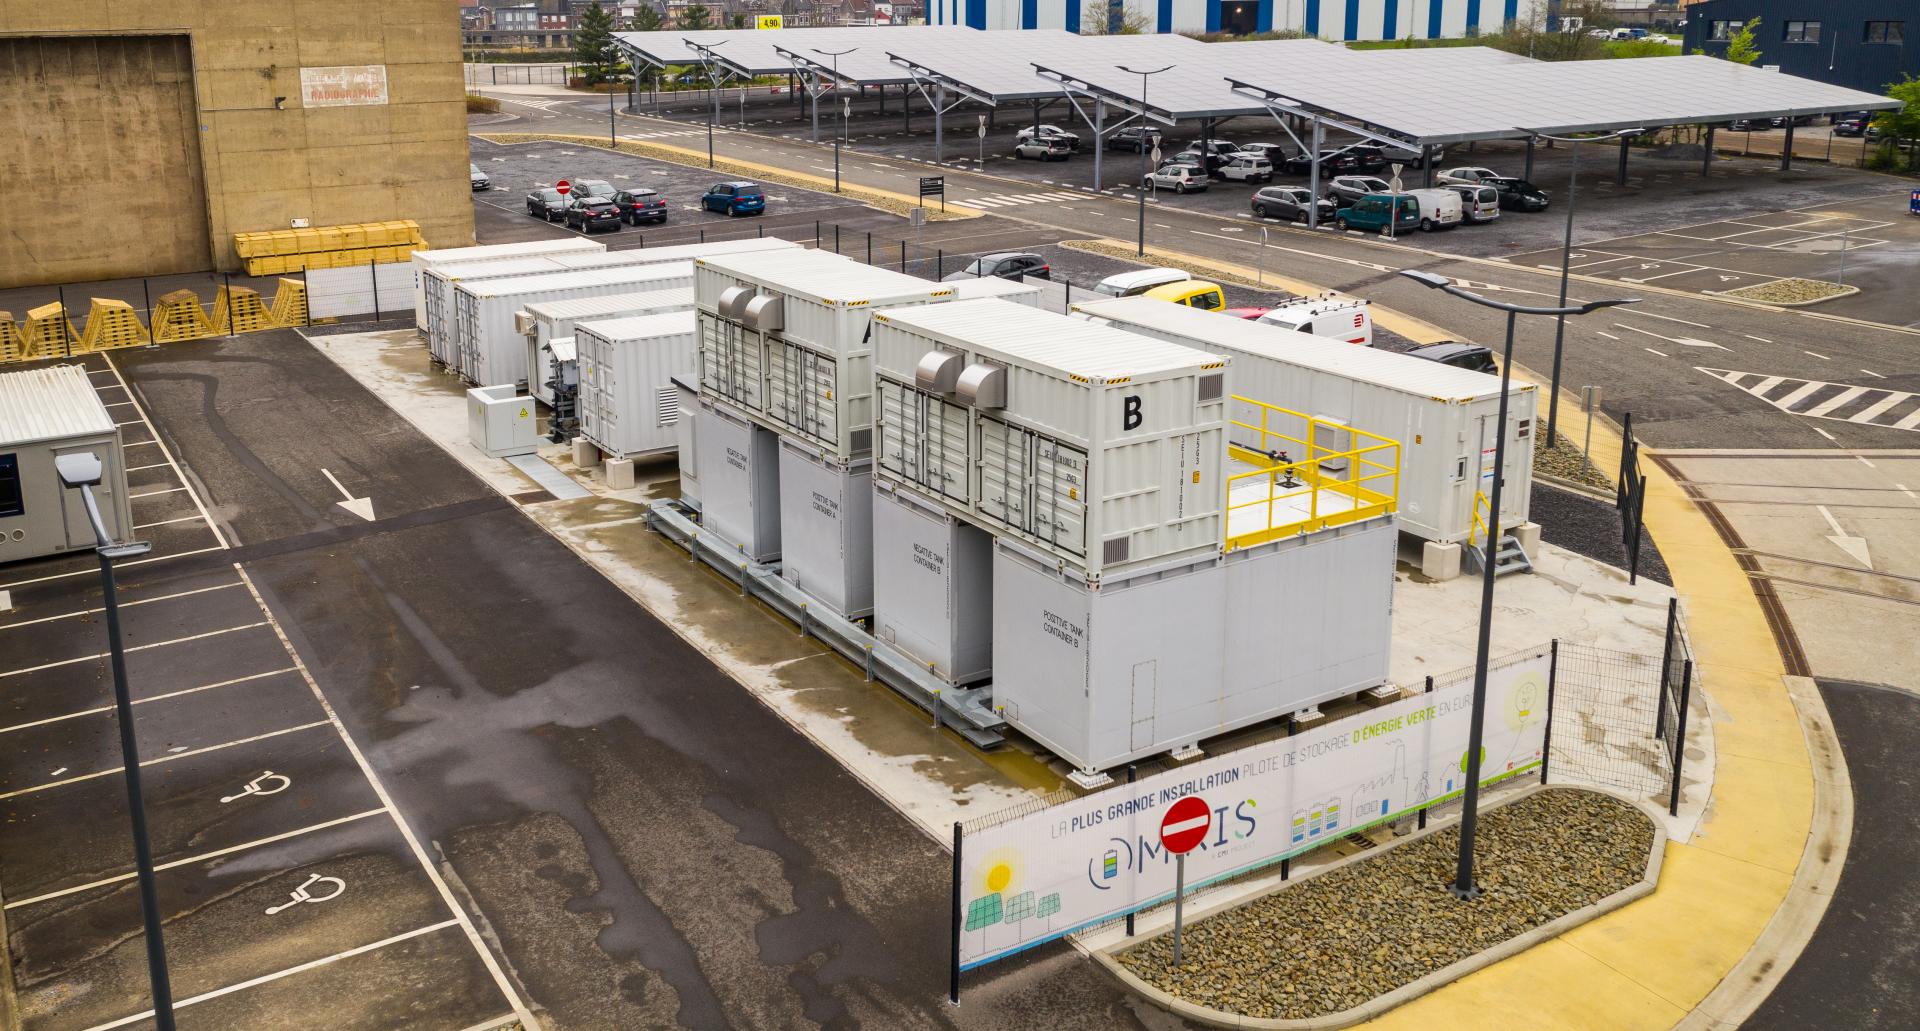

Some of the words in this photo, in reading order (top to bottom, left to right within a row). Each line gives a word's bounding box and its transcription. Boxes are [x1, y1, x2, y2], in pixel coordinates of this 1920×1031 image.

[1123, 395, 1143, 431] B
[829, 499, 838, 511] TANK
[913, 543, 932, 560] NEGATIVE
[933, 552, 945, 566] TANK
[913, 553, 937, 573] CONTAINER
[1043, 609, 1068, 630] POSITIVE
[1070, 623, 1084, 639] TANK
[1043, 622, 1073, 645] CONTAINER
[1074, 638, 1079, 648] B
[1052, 820, 1067, 839] LA
[1072, 809, 1103, 833] PLUS
[1108, 792, 1155, 821] GRANDE
[1160, 767, 1239, 804] INSTALLATION
[1243, 755, 1279, 778] PILOTE
[1283, 751, 1296, 768] DE
[1300, 732, 1350, 762] STOCKAGE
[1353, 714, 1403, 744] D'ÉNERGIE
[1407, 704, 1436, 726] VERTE
[1440, 699, 1450, 716] EN
